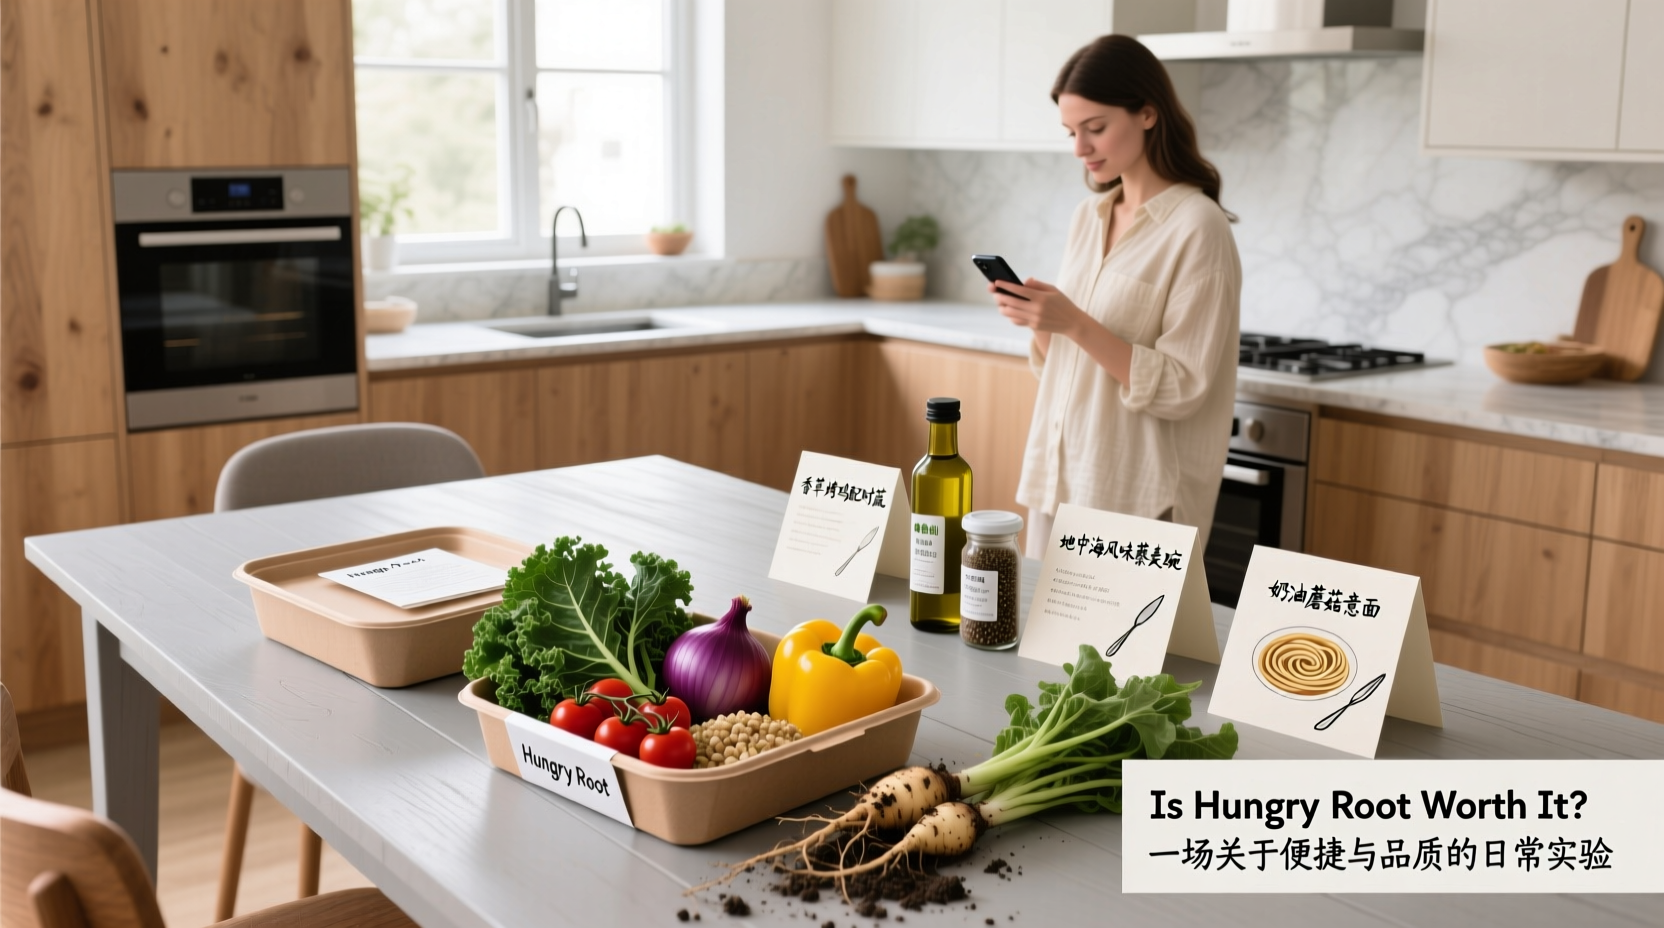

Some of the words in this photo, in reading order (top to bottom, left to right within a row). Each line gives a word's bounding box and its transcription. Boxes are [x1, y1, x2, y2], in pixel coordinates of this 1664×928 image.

[1268, 579, 1381, 618] 奶油蘑菇意面
[521, 743, 572, 787] Hungry
[575, 766, 610, 797] Root
